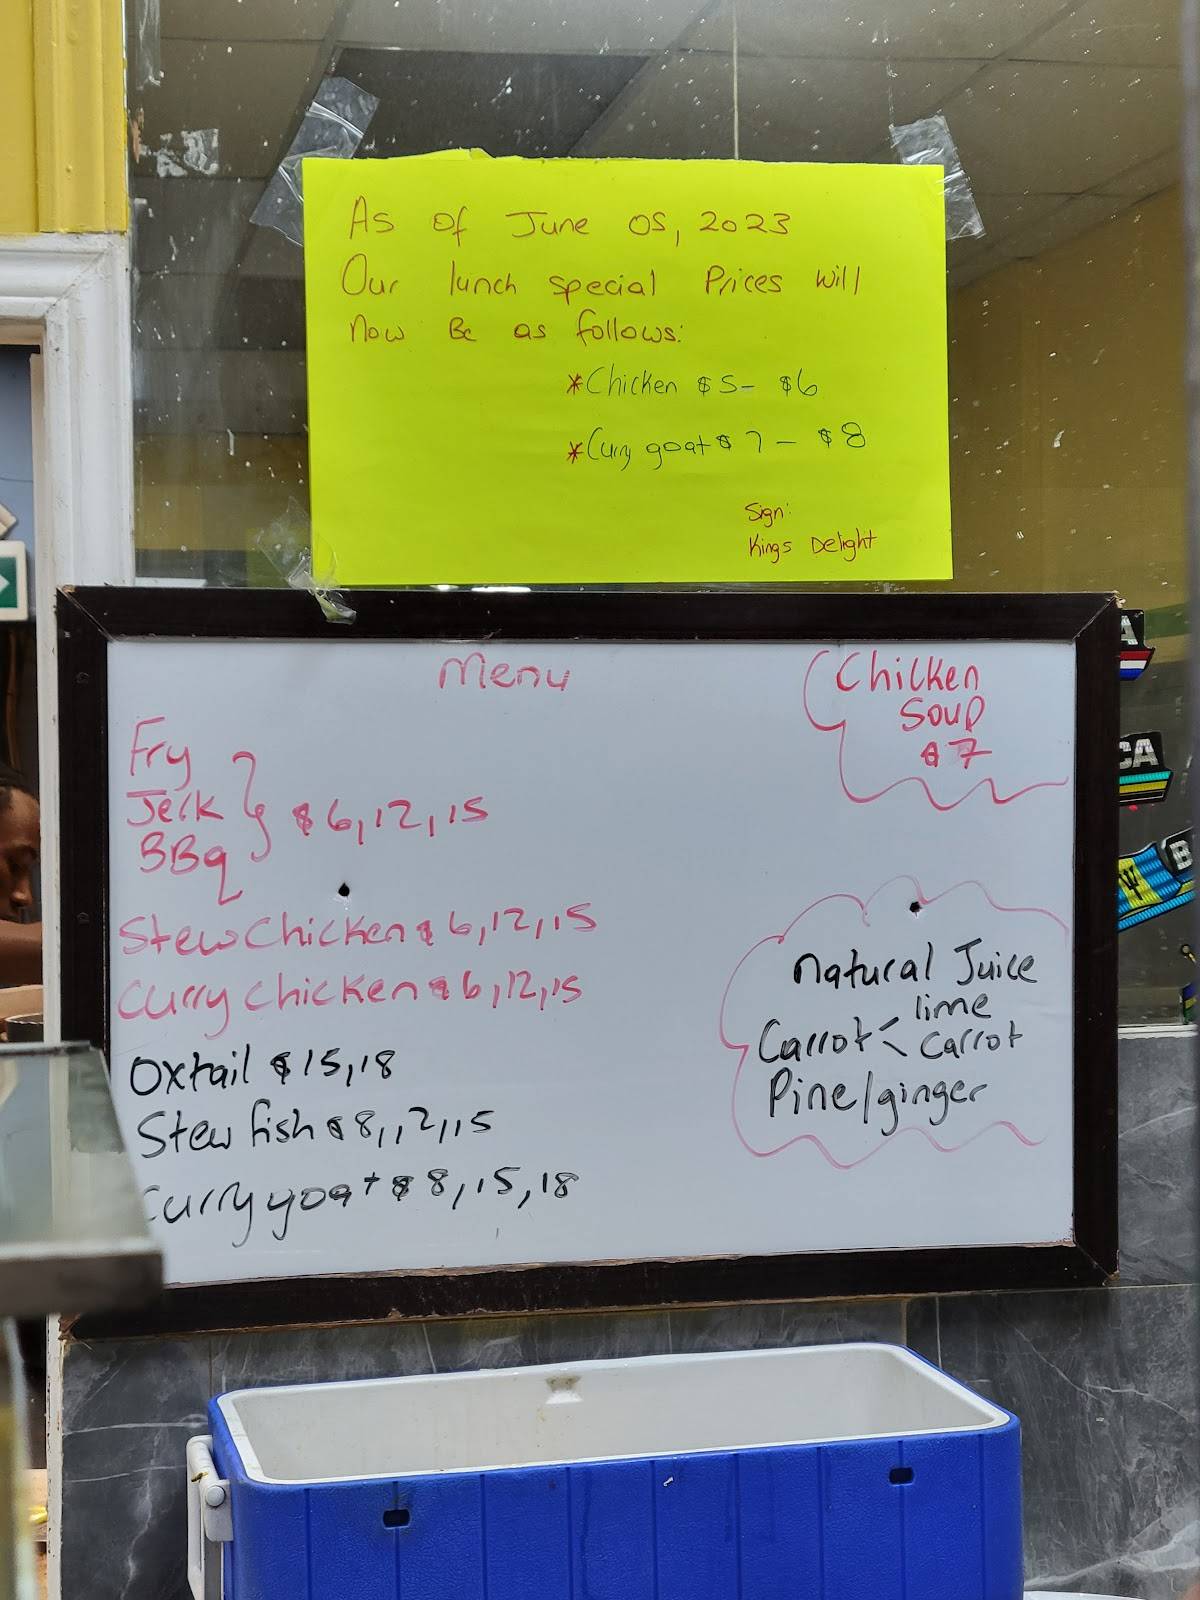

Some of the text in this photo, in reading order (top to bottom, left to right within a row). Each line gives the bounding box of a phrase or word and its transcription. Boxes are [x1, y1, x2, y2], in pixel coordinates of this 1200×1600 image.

[350, 196, 394, 239] As
[505, 212, 588, 238] June
[700, 211, 790, 234] 2023
[342, 253, 399, 295] Our
[451, 260, 516, 296] lunch
[549, 269, 655, 305] special
[514, 324, 546, 341] as
[646, 435, 711, 470] goat
[749, 529, 877, 563] Kings Delight
[130, 716, 191, 791] Fry
[127, 790, 224, 826] Jerk
[120, 914, 238, 956] Stew
[953, 938, 1037, 986] Juice
[916, 993, 991, 1021] lime
[759, 1016, 872, 1063] Carrot
[130, 1043, 250, 1096] Oxtail
[137, 1110, 231, 1159] Stew
